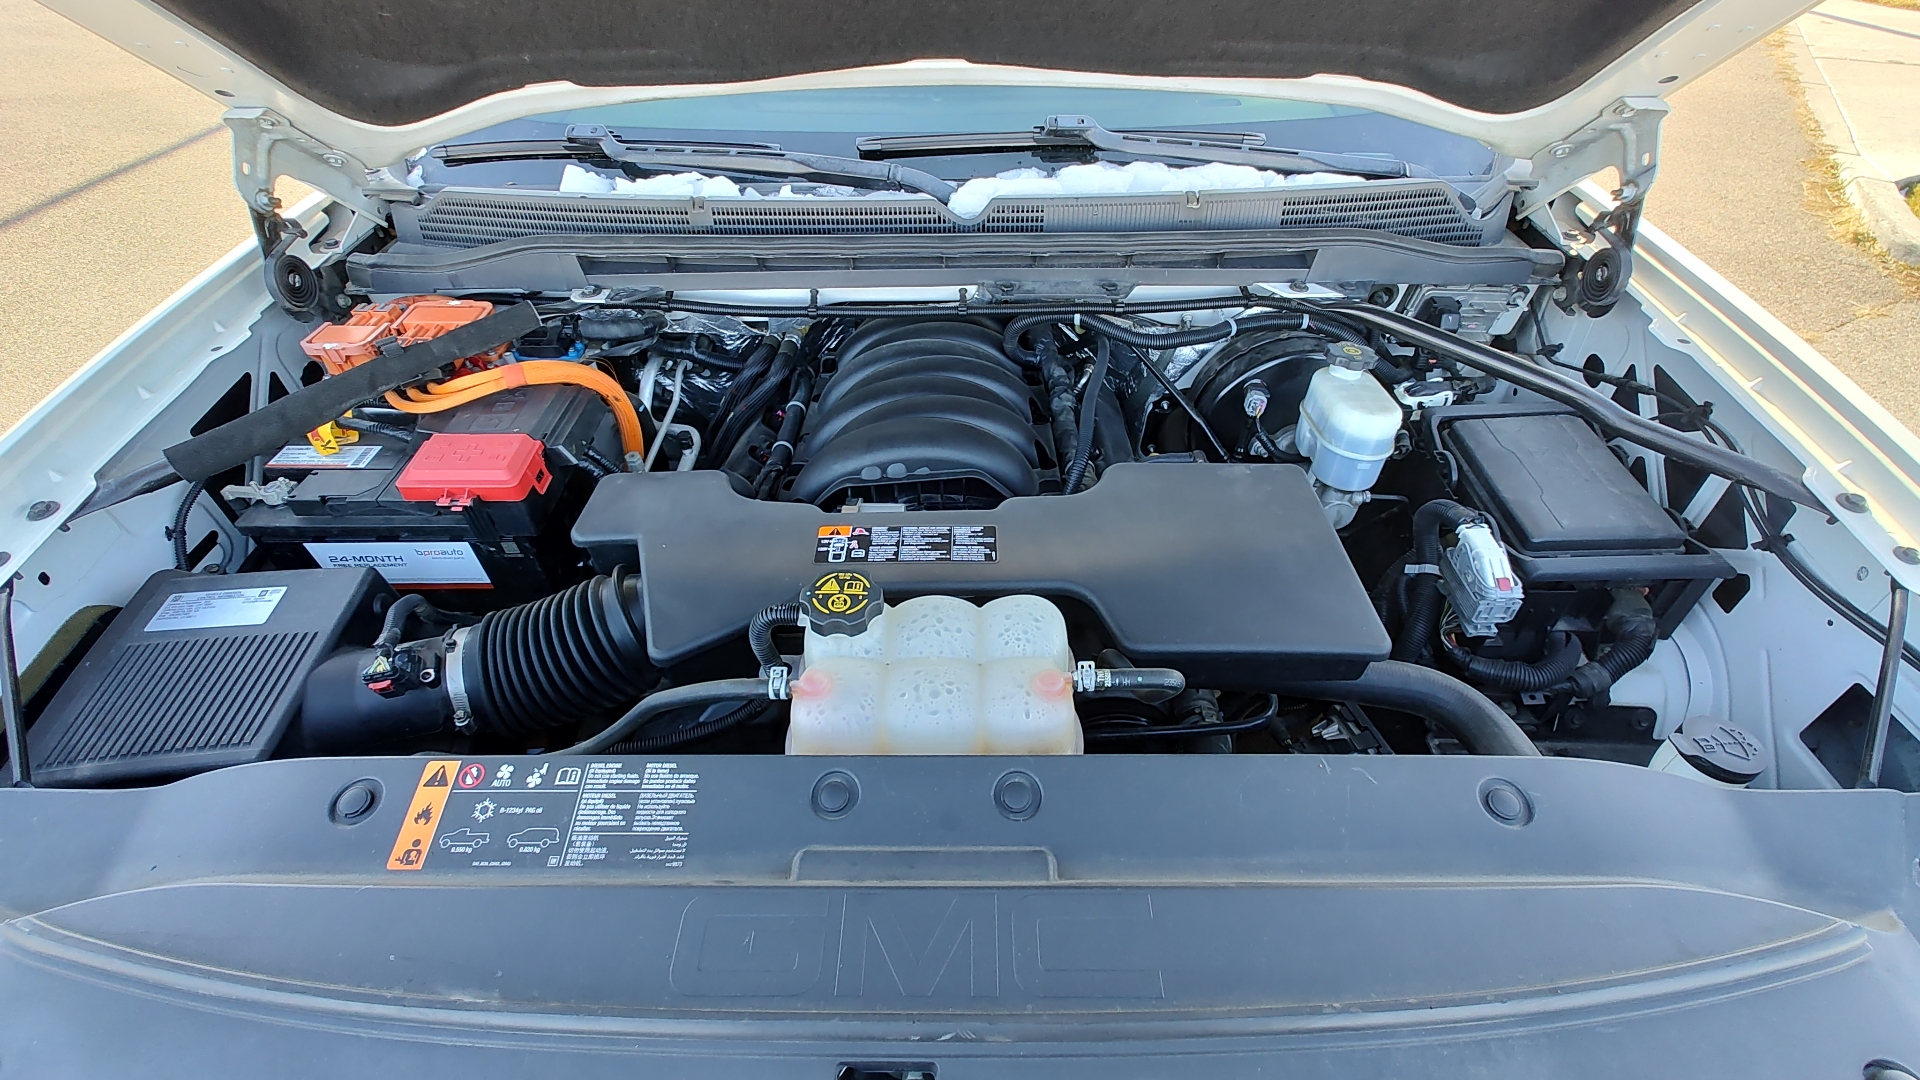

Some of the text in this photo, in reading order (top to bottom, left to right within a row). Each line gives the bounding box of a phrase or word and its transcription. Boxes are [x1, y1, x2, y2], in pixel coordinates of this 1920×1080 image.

[328, 555, 404, 563] 24-MONTH
[491, 779, 511, 787] AUTO
[669, 894, 1165, 999] GMC
